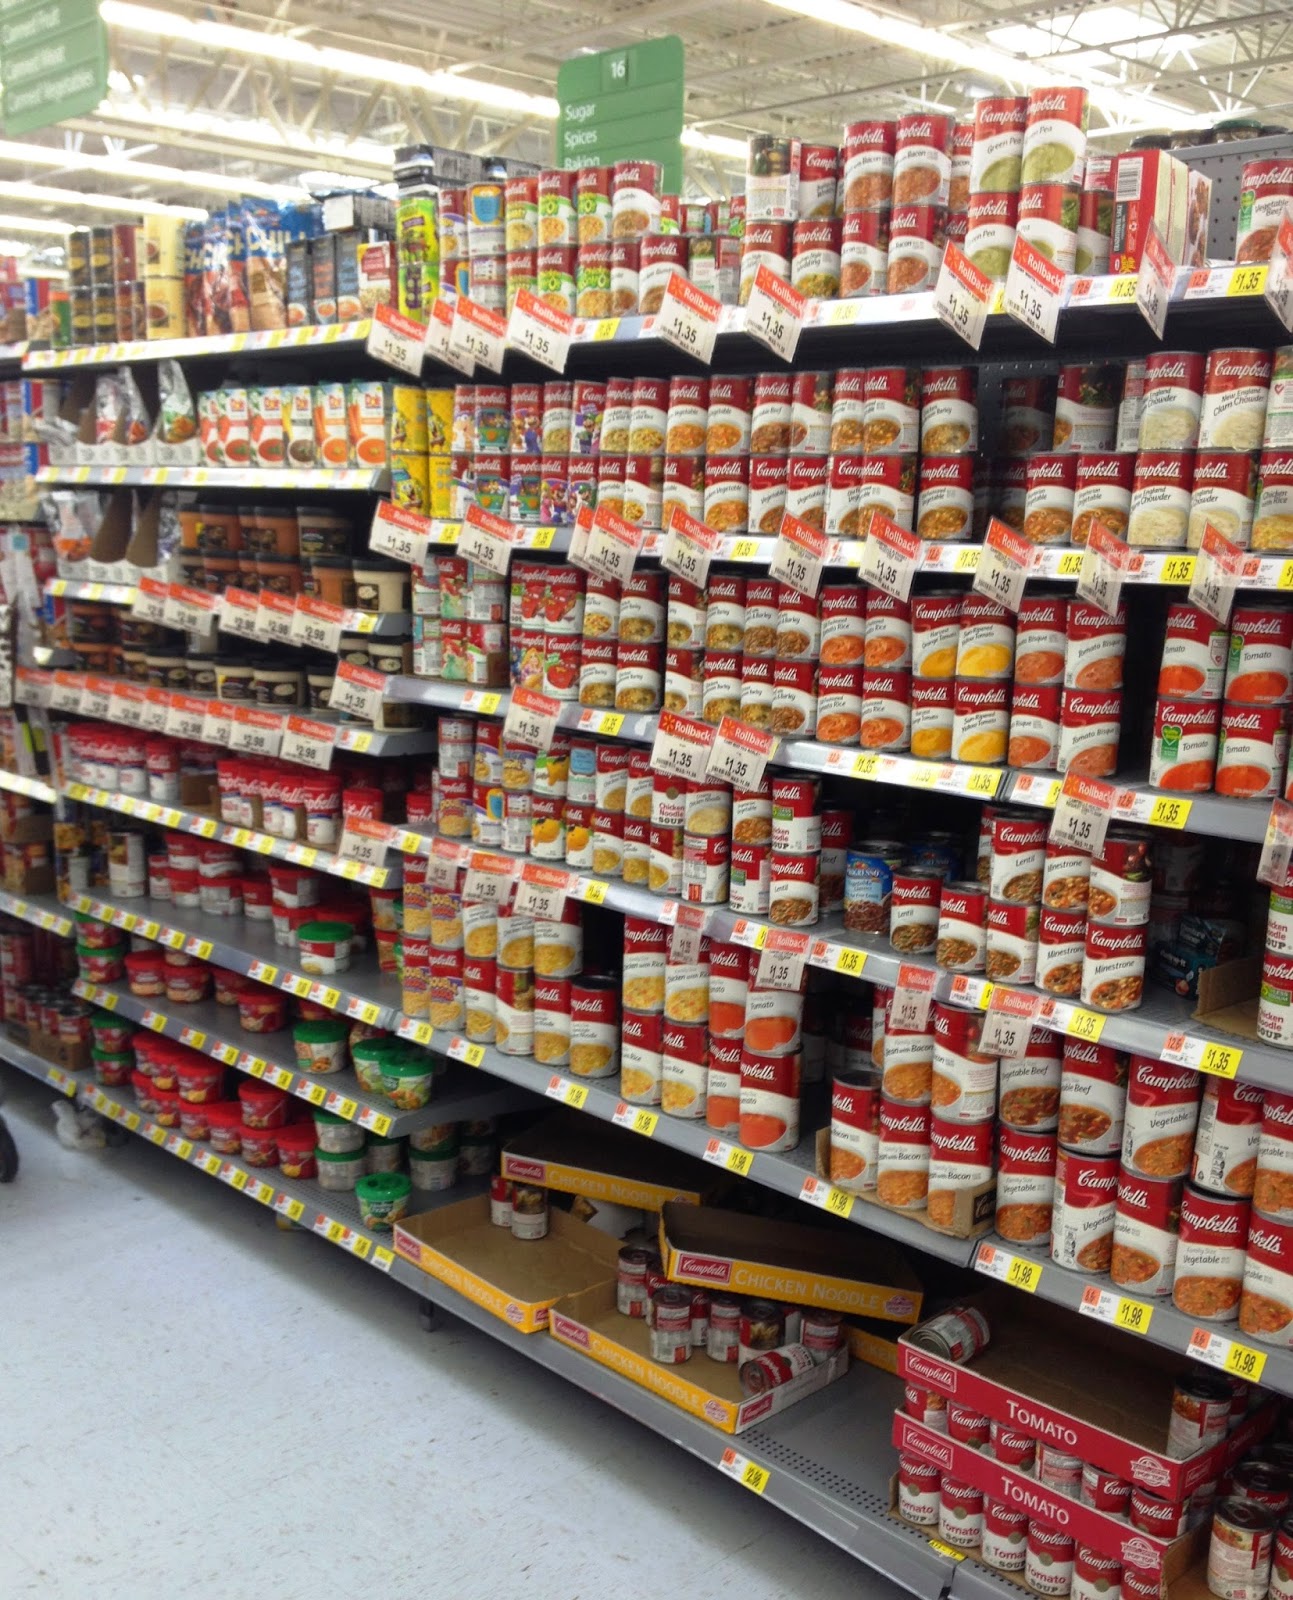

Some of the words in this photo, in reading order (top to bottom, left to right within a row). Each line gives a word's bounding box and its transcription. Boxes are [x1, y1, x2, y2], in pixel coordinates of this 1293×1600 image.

[611, 61, 625, 78] 16
[565, 104, 595, 122] Sugar
[564, 129, 597, 149] Spices
[564, 155, 599, 168] Baking
[1255, 199, 1289, 213] Vegetable
[1027, 253, 1062, 288] Rollback
[1236, 272, 1261, 290] $1.35
[949, 294, 969, 323] $1.35
[1020, 289, 1042, 320] $1.35
[674, 318, 697, 343] $1.35
[762, 311, 784, 338] $1.35
[466, 335, 489, 356] $1.35
[525, 329, 550, 353] $1.35
[1222, 393, 1235, 402] New
[1237, 389, 1260, 397] England
[1214, 402, 1233, 416] Clam
[1234, 396, 1264, 406] Chowder
[387, 536, 411, 554] $1.35
[884, 526, 917, 555] Rollback
[473, 541, 494, 560] $1.35
[601, 547, 620, 568] $1.35
[678, 550, 696, 572] $1.35
[787, 559, 807, 581] $1.35
[1167, 561, 1190, 579] $1.35
[877, 560, 896, 584] $1.35
[992, 569, 1012, 594] $1.35
[1078, 643, 1101, 658] Tomato
[1244, 651, 1272, 661] Tomato
[1161, 706, 1217, 726] Campbell's
[518, 721, 540, 738] $1.35
[674, 721, 710, 742] Rollback
[735, 728, 770, 749] Rollback
[1072, 730, 1095, 745] Tomato
[1183, 741, 1208, 751] Tomato
[669, 748, 692, 767] $1.35
[726, 756, 748, 777] $1.35
[973, 774, 991, 789] $1.35
[659, 802, 685, 811] Chicken
[660, 808, 684, 816] Noodle
[1157, 802, 1180, 821] $1.35
[658, 816, 684, 824] SOUP
[1069, 817, 1092, 838] $1.35
[1015, 855, 1035, 867] Lentil
[476, 882, 496, 897] $1.35
[529, 896, 549, 911] $1.35
[898, 910, 914, 918] Lentil
[1090, 930, 1143, 950] Campbell's
[842, 952, 859, 969] $1.35
[1095, 960, 1135, 974] Minestrone
[770, 967, 788, 980] $1.35
[1003, 993, 1034, 1010] Rollback
[901, 1005, 916, 1020] $1.35
[1075, 1014, 1094, 1034] $1.35
[995, 1029, 1015, 1046] $1.35
[911, 1044, 933, 1053] Bacon
[1207, 1049, 1230, 1070] $1.35
[1032, 1066, 1049, 1076] Beef
[1074, 1084, 1092, 1095] Beef
[1150, 1113, 1189, 1129] Vegetable
[899, 1153, 921, 1161] Bacon
[948, 1172, 971, 1180] Bacon
[549, 1170, 607, 1193] CHICKEN
[611, 1182, 668, 1205] NOODLE
[1004, 1184, 1036, 1194] Vegetable
[1083, 1213, 1115, 1231] Vegetab
[1183, 1255, 1220, 1264] Vegetable
[681, 1258, 727, 1280] Campbell's
[1013, 1262, 1033, 1284] $1.98
[734, 1268, 807, 1294] CHICKEN
[813, 1283, 880, 1310] NOODLE
[1121, 1303, 1142, 1326] $1.98
[908, 1355, 951, 1385] Campbell's
[1232, 1349, 1256, 1373] $1.98
[592, 1340, 645, 1381] CHICKEN
[650, 1371, 700, 1408] NOODLE
[1006, 1399, 1077, 1446] TOMATO
[906, 1430, 948, 1462] Campbell's
[1001, 1476, 1070, 1525] TOMATO
[902, 1510, 927, 1522] SOUP
[941, 1520, 980, 1536] Tomato
[946, 1534, 973, 1545] SOUP
[1000, 1561, 1025, 1570] SOUP
[1027, 1564, 1067, 1584] Tomato
[1030, 1579, 1059, 1593] SOUP
